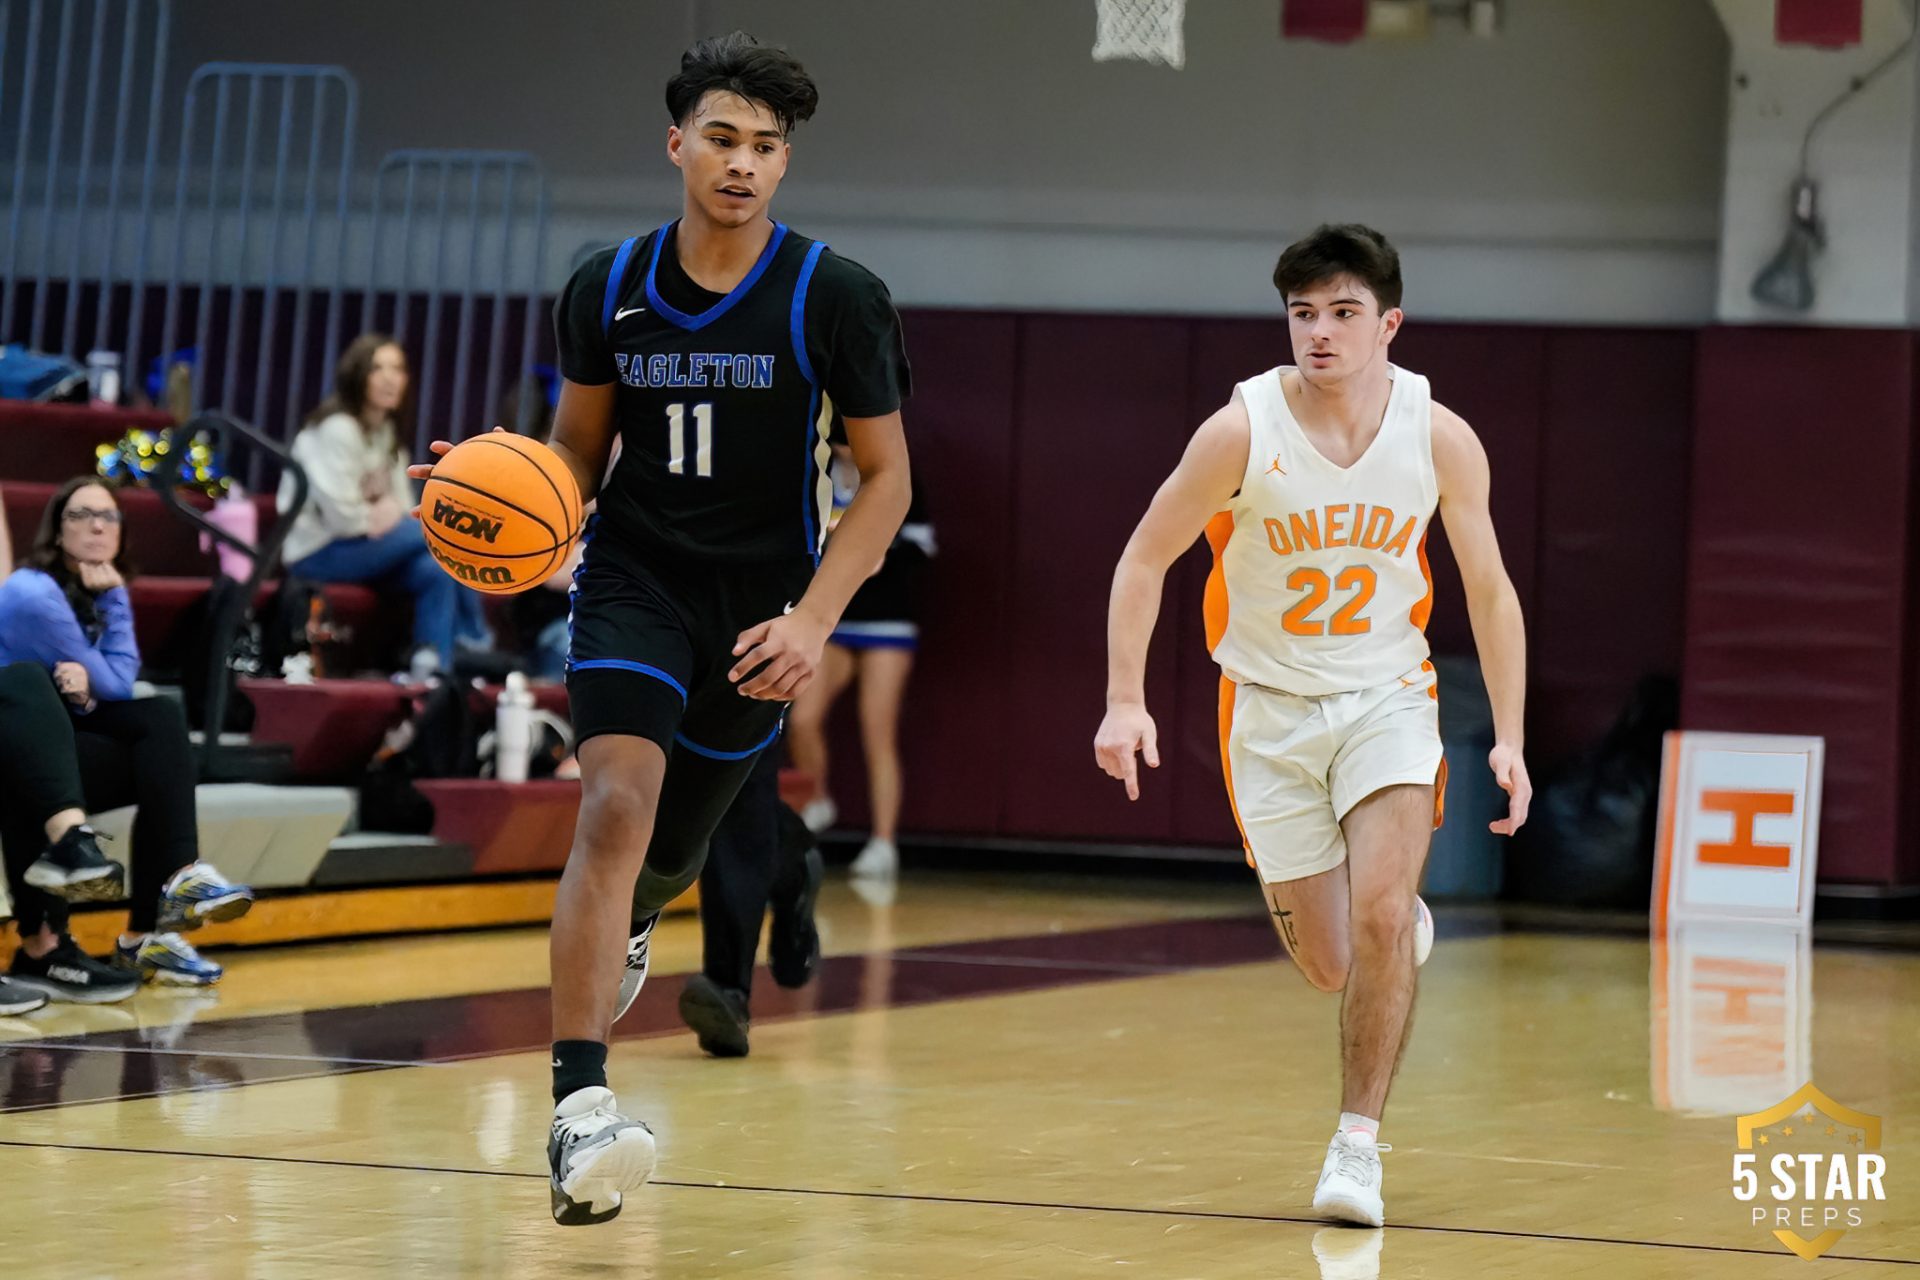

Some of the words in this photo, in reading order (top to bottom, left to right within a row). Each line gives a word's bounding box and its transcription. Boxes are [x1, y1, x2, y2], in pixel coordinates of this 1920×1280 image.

[615, 353, 774, 388] EAGLETON
[666, 403, 712, 477] 11
[433, 499, 503, 543] NCAA
[1264, 504, 1417, 557] ONEIDA
[1281, 565, 1377, 636] 22
